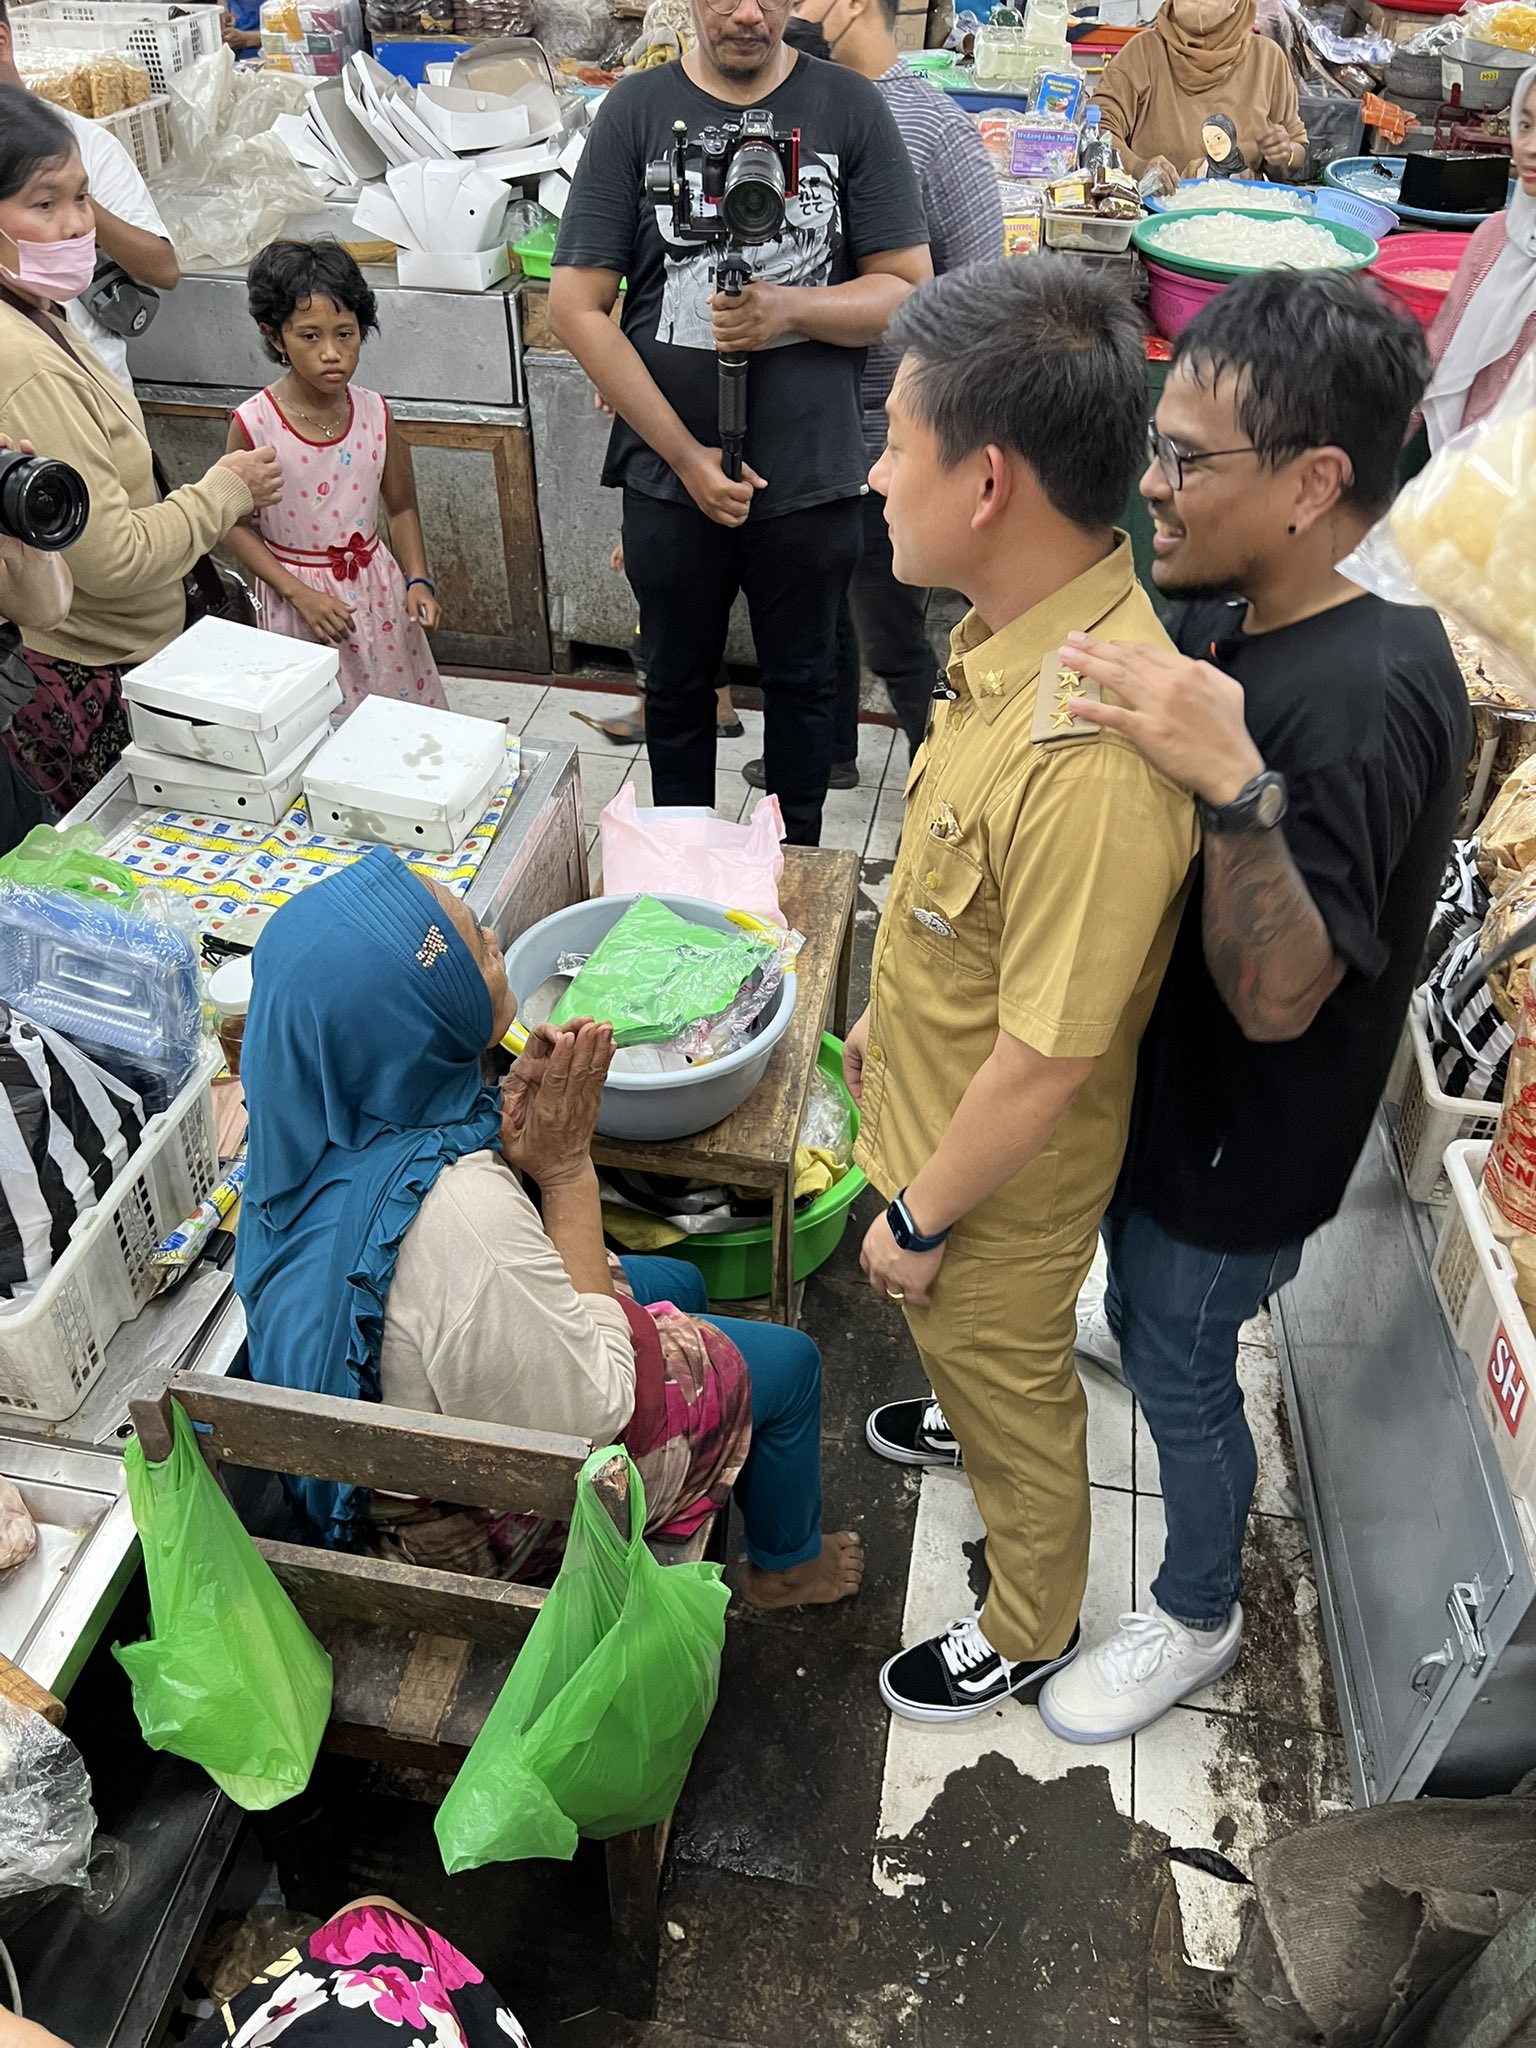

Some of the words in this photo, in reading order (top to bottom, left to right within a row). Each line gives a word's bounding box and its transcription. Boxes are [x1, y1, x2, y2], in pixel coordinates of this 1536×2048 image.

[1017, 132, 1041, 141] Wedang
[1042, 133, 1056, 141] Jahe
[1057, 134, 1076, 144] Telang
[1490, 1337, 1526, 1424] SH
